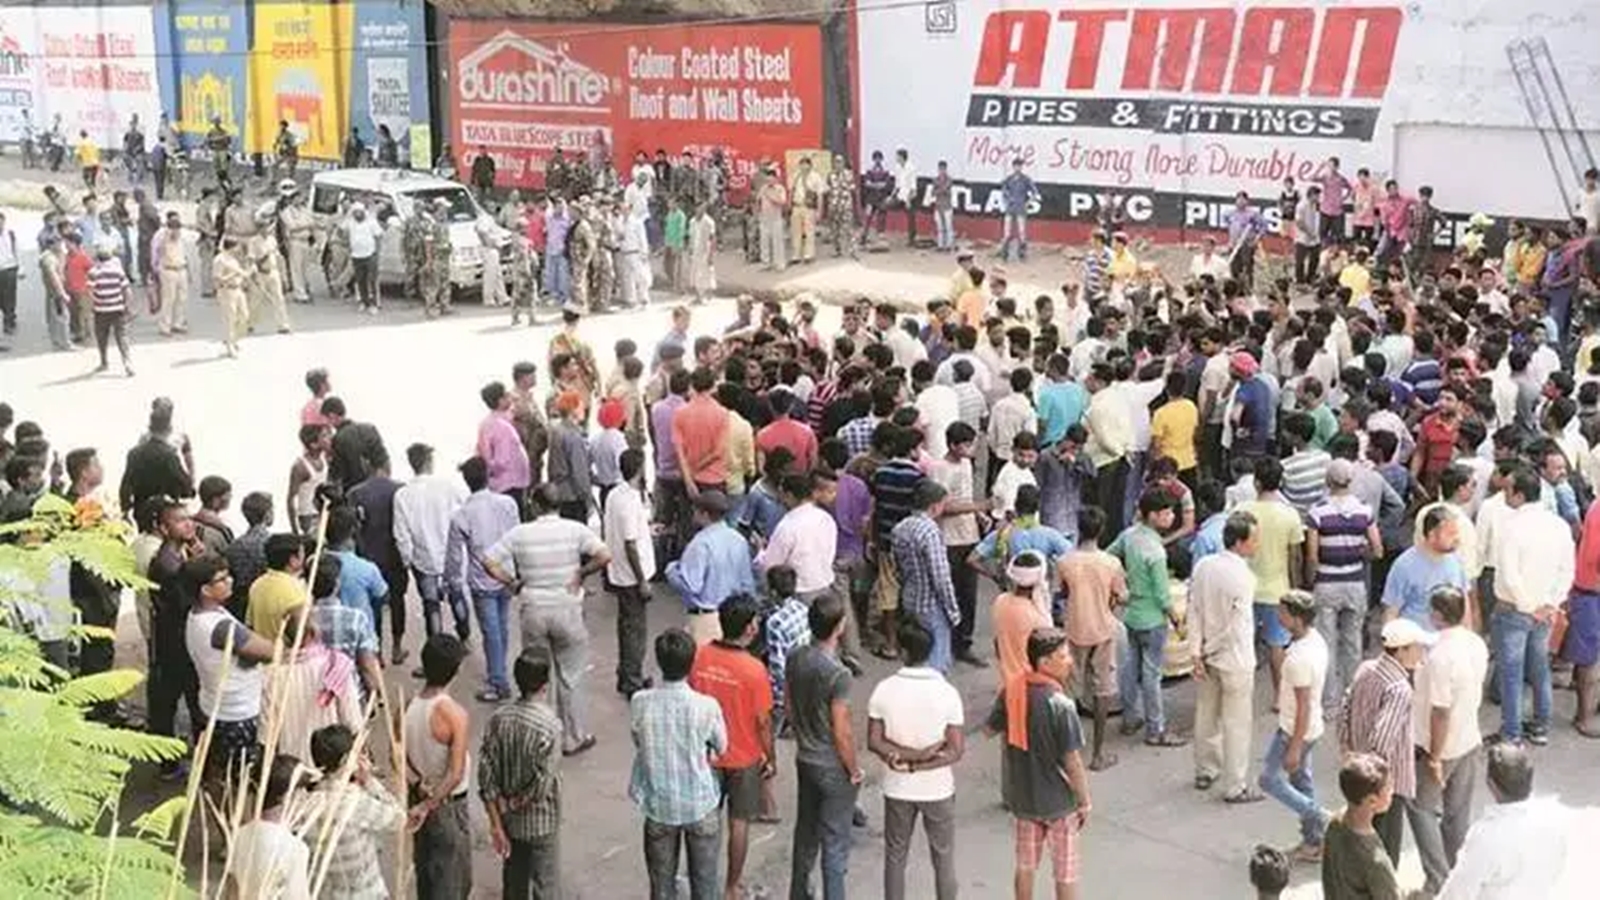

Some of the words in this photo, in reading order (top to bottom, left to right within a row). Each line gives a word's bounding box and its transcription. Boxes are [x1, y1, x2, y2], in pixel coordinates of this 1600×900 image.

[628, 47, 675, 79] Colour
[682, 47, 739, 80] Coated
[744, 47, 790, 80] Steel
[973, 8, 1403, 98] ATMAN
[630, 86, 664, 119] Roof
[669, 88, 697, 120] and
[703, 89, 738, 121] Wall
[743, 88, 802, 123] Sheets
[982, 101, 1078, 123] PIPES
[1111, 102, 1139, 126] &
[1164, 105, 1345, 135] FITTINGS
[465, 126, 496, 142] TATA
[1049, 138, 1132, 184] Strong
